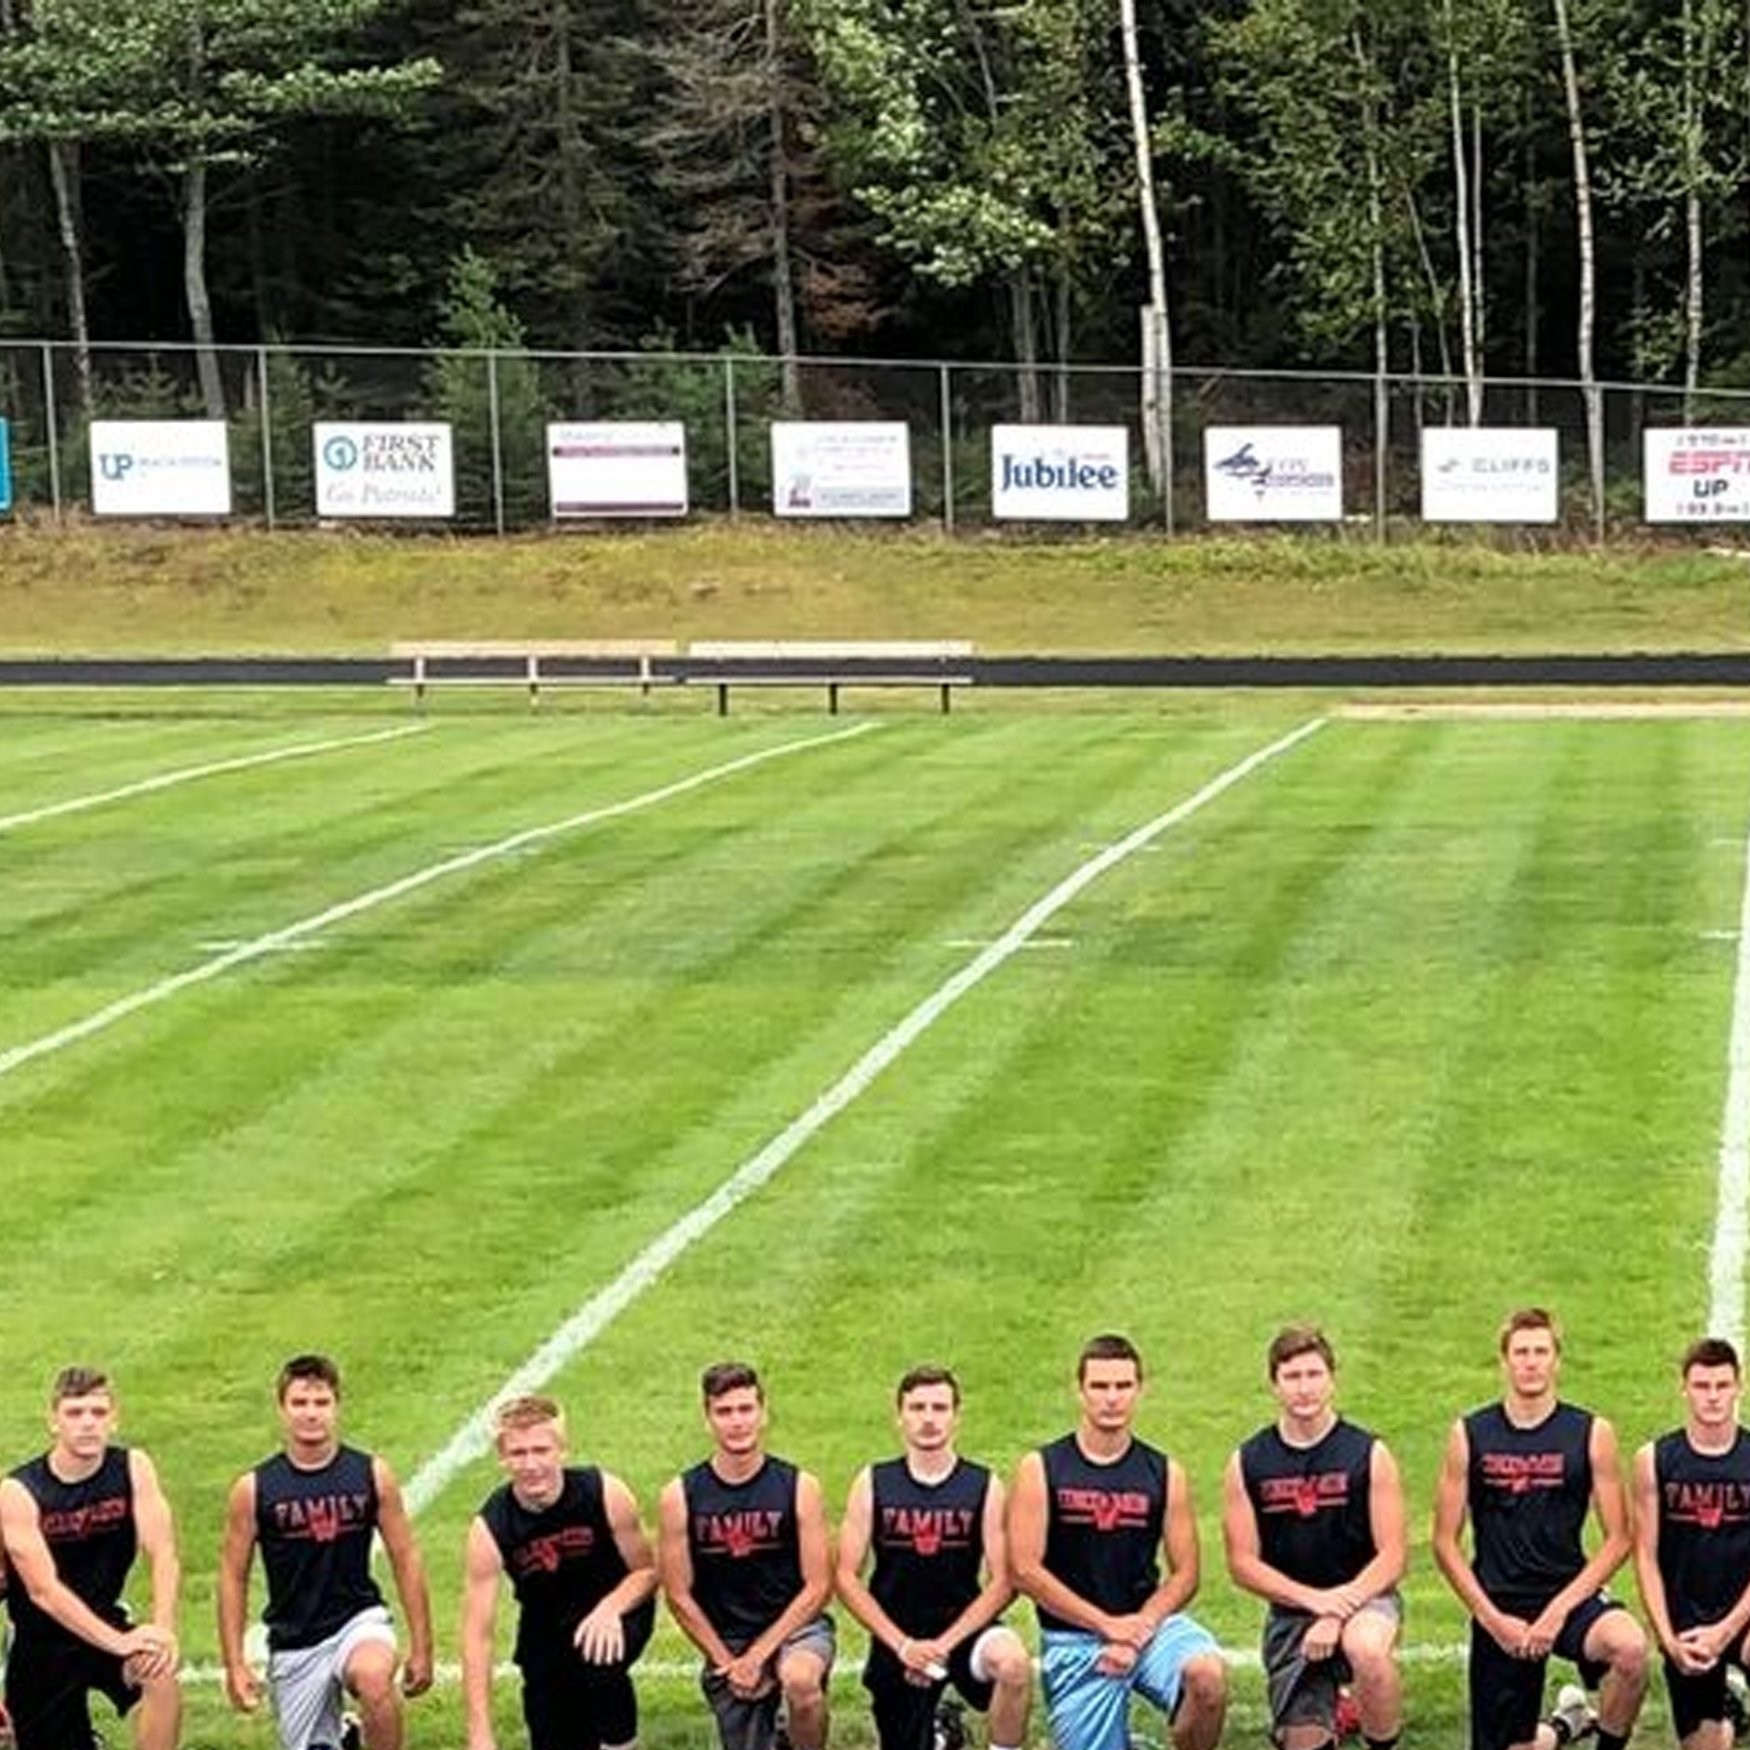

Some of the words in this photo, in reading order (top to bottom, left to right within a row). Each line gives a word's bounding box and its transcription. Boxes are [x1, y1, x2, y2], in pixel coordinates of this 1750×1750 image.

[362, 434, 441, 459] FIRST
[363, 452, 435, 472] BANK
[1001, 454, 1119, 492] Jubilee
[1693, 479, 1729, 498] UP
[274, 1494, 369, 1529] FAMILY
[695, 1510, 784, 1541] FAMILY
[882, 1506, 976, 1536] FAMILY
